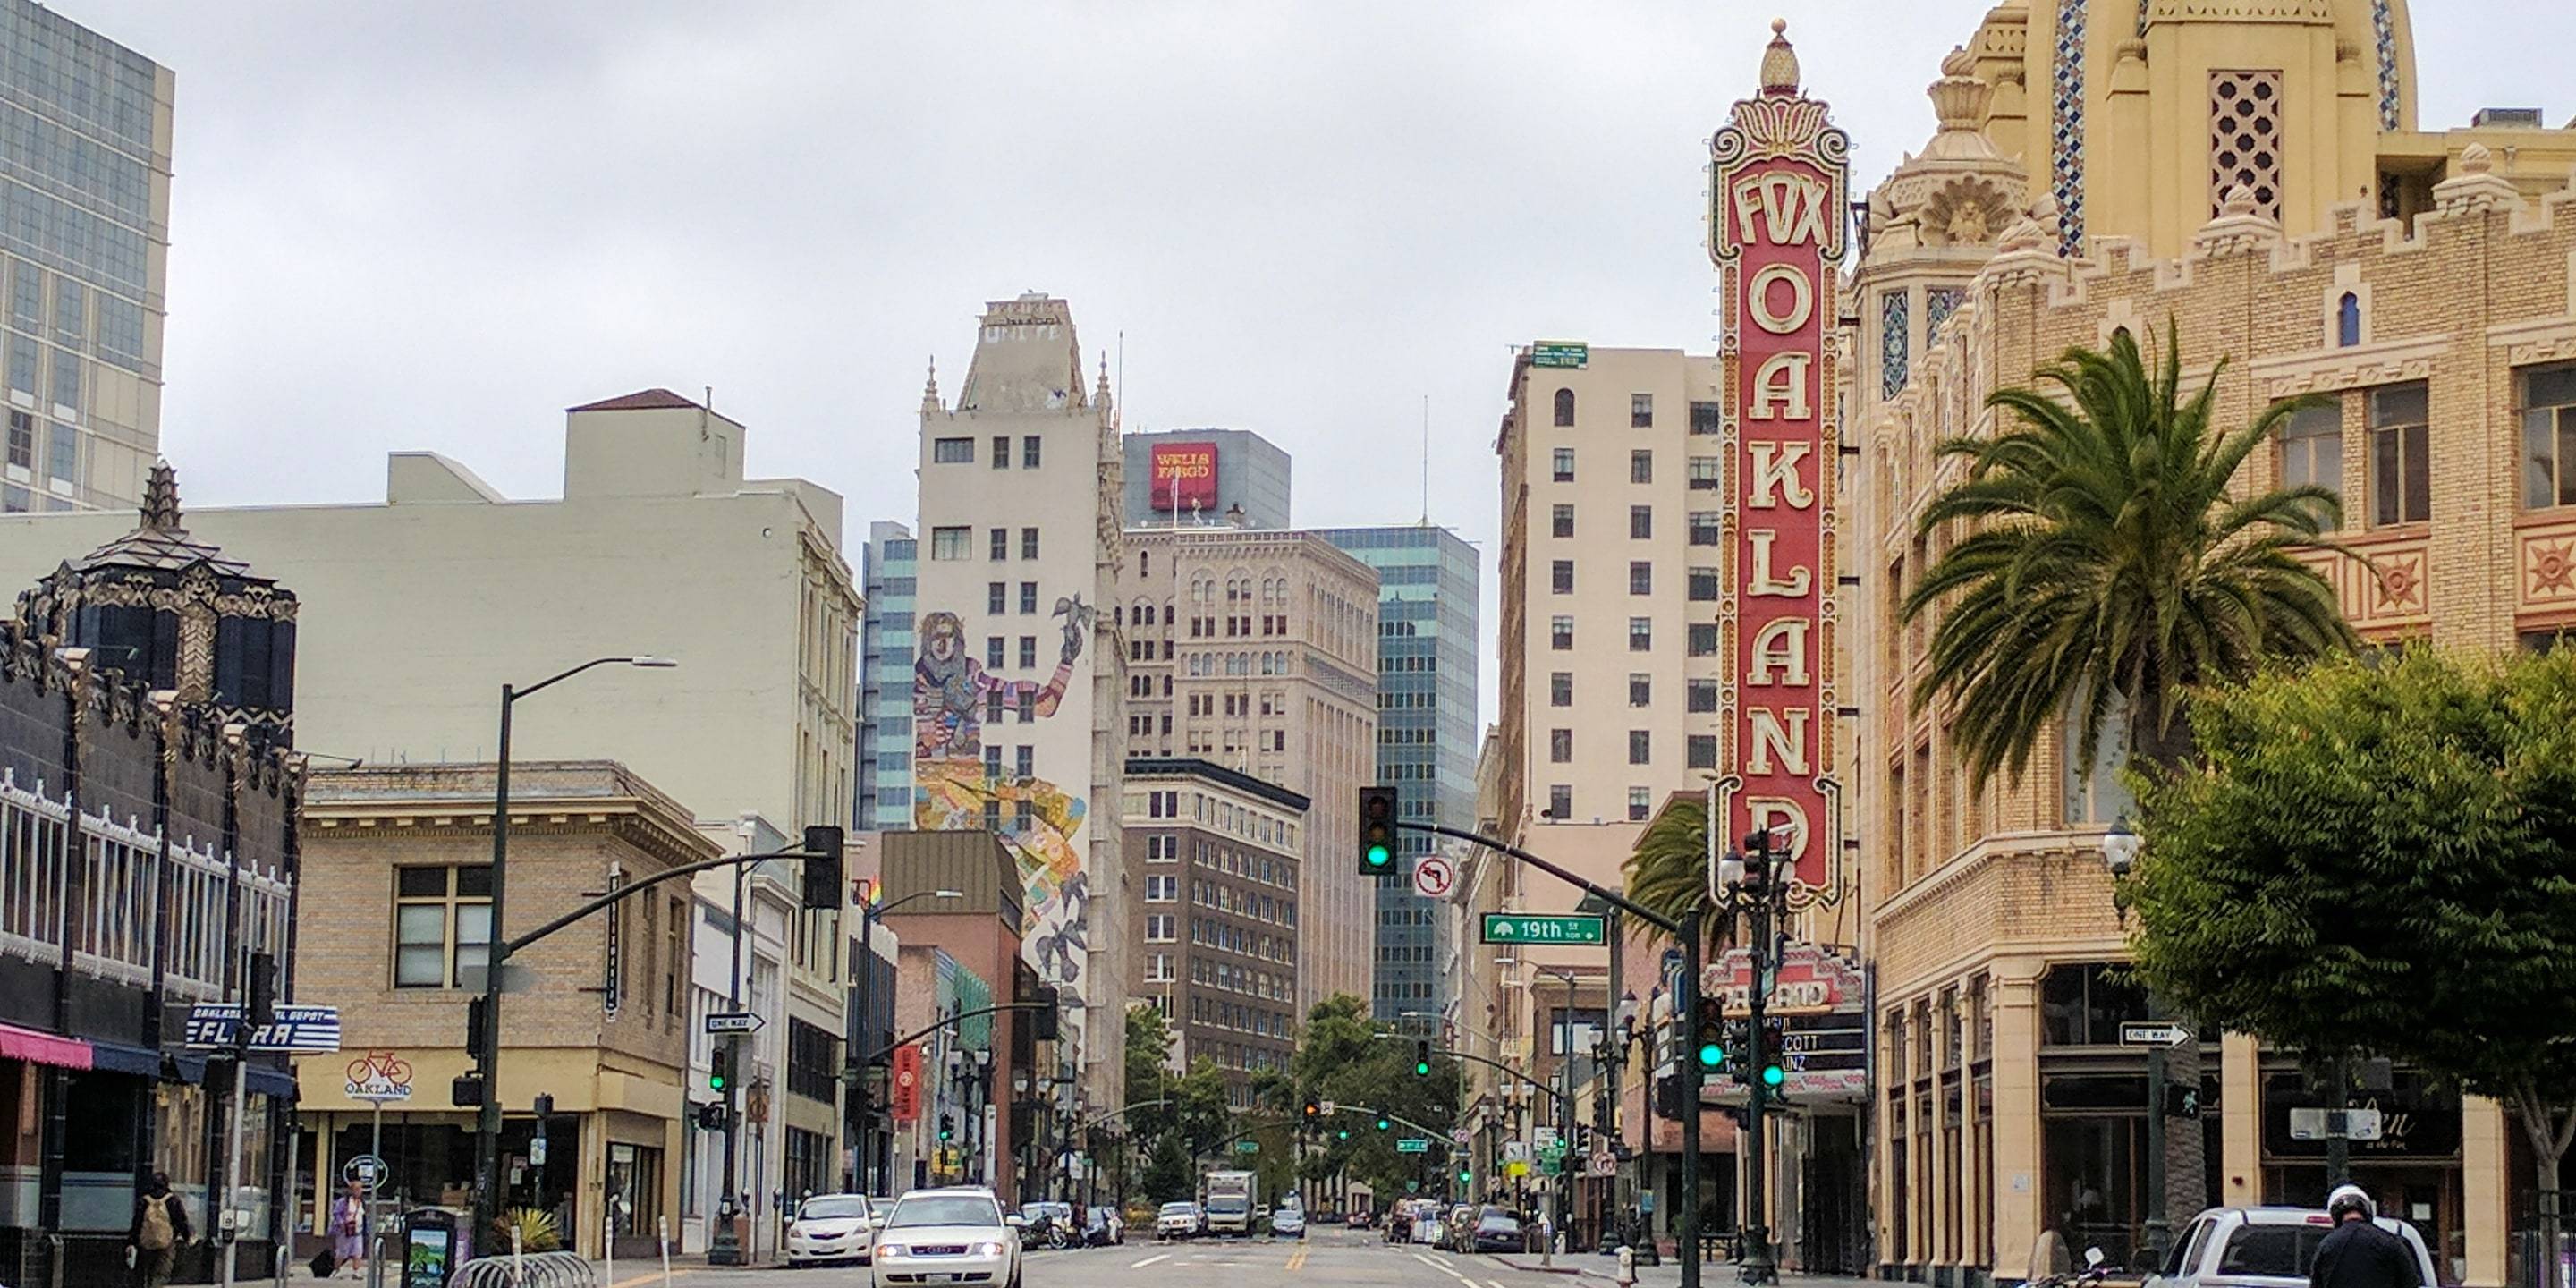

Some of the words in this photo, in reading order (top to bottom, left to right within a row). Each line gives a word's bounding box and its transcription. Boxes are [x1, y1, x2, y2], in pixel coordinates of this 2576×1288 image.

[1733, 171, 1829, 245] FOX
[1157, 453, 1209, 465] WELLS
[1157, 465, 1209, 479] FARGO
[1746, 262, 1813, 864] OAKLAND
[1521, 921, 1562, 938] 19th
[289, 1011, 325, 1021] DEPOT
[711, 1020, 727, 1028] ONE
[199, 1021, 292, 1046] FLRA
[2128, 1030, 2149, 1039] ONE
[2151, 1030, 2172, 1039] WAY
[1782, 1035, 1818, 1051] COTT
[344, 1082, 413, 1096] OAKLAND
